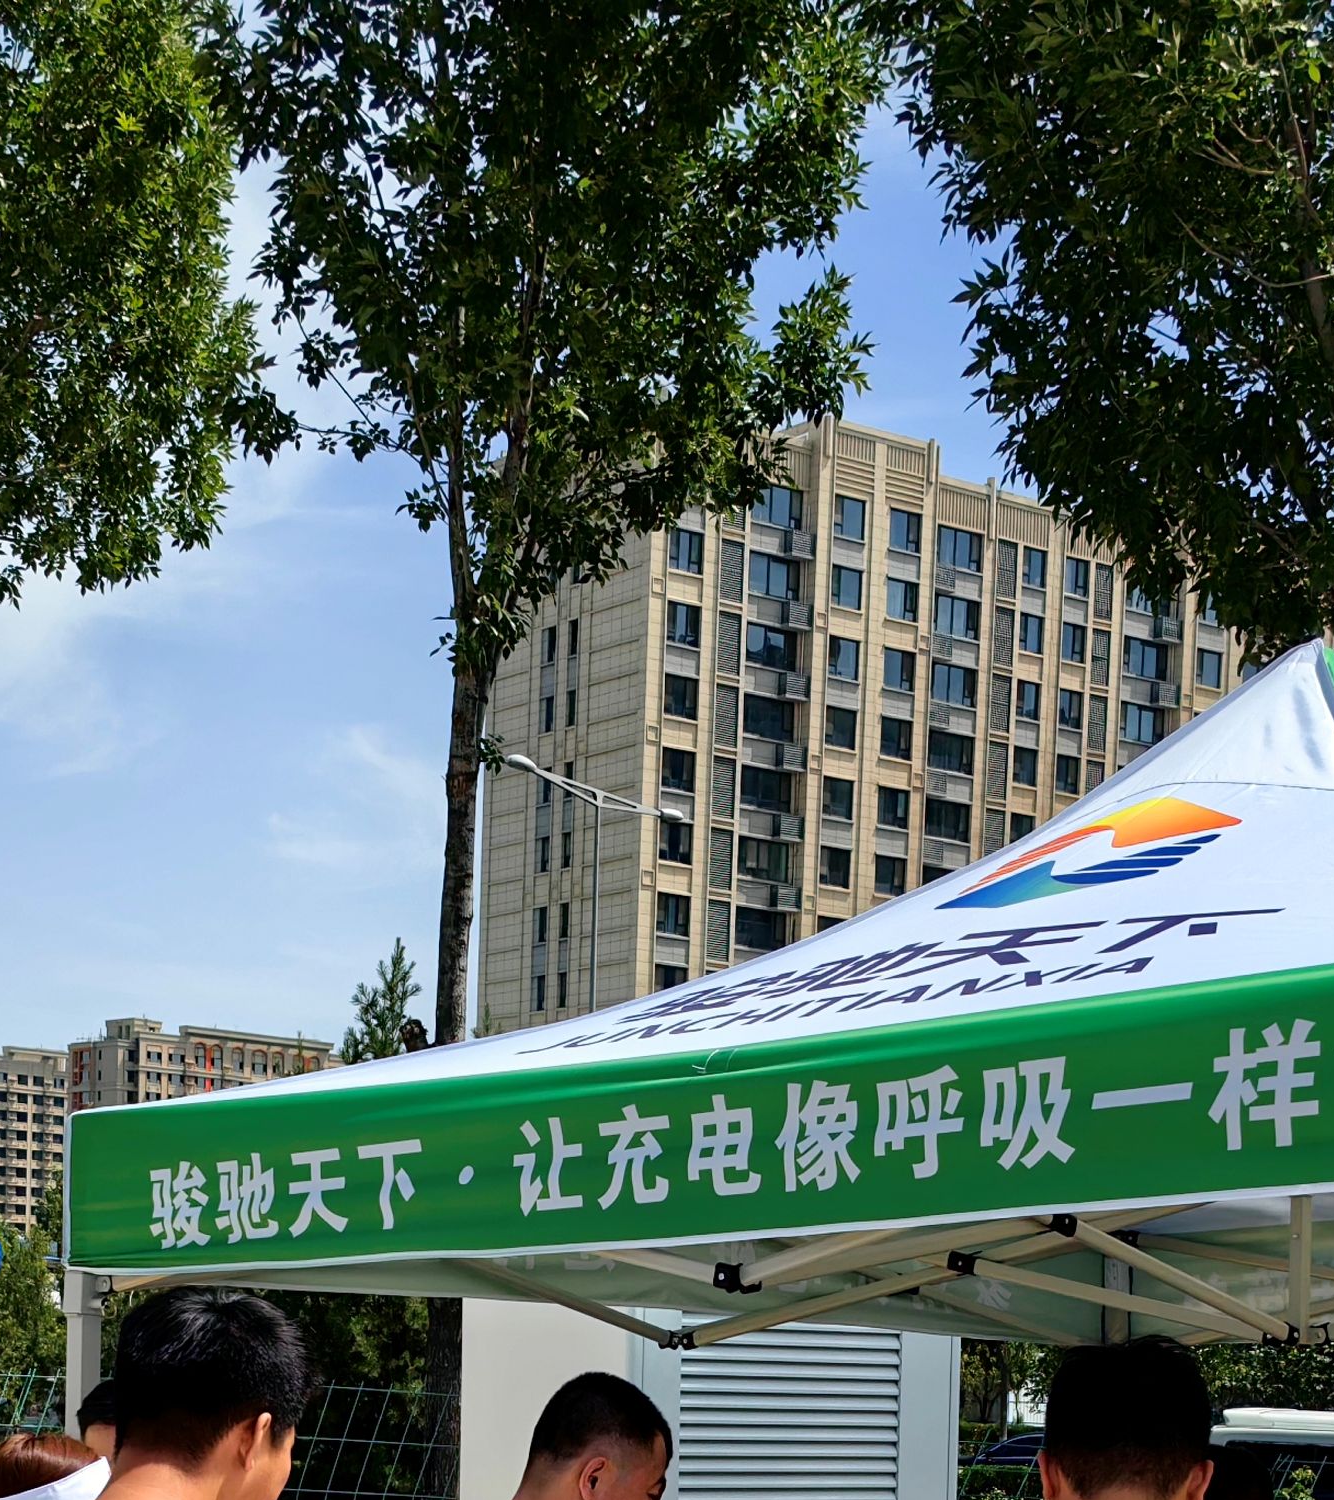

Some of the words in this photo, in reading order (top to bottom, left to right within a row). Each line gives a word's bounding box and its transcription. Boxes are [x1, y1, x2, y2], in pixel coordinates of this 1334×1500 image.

[516, 956, 1154, 1055] JUNCHITIANXIA
[617, 908, 1286, 1024] 骏驰天下
